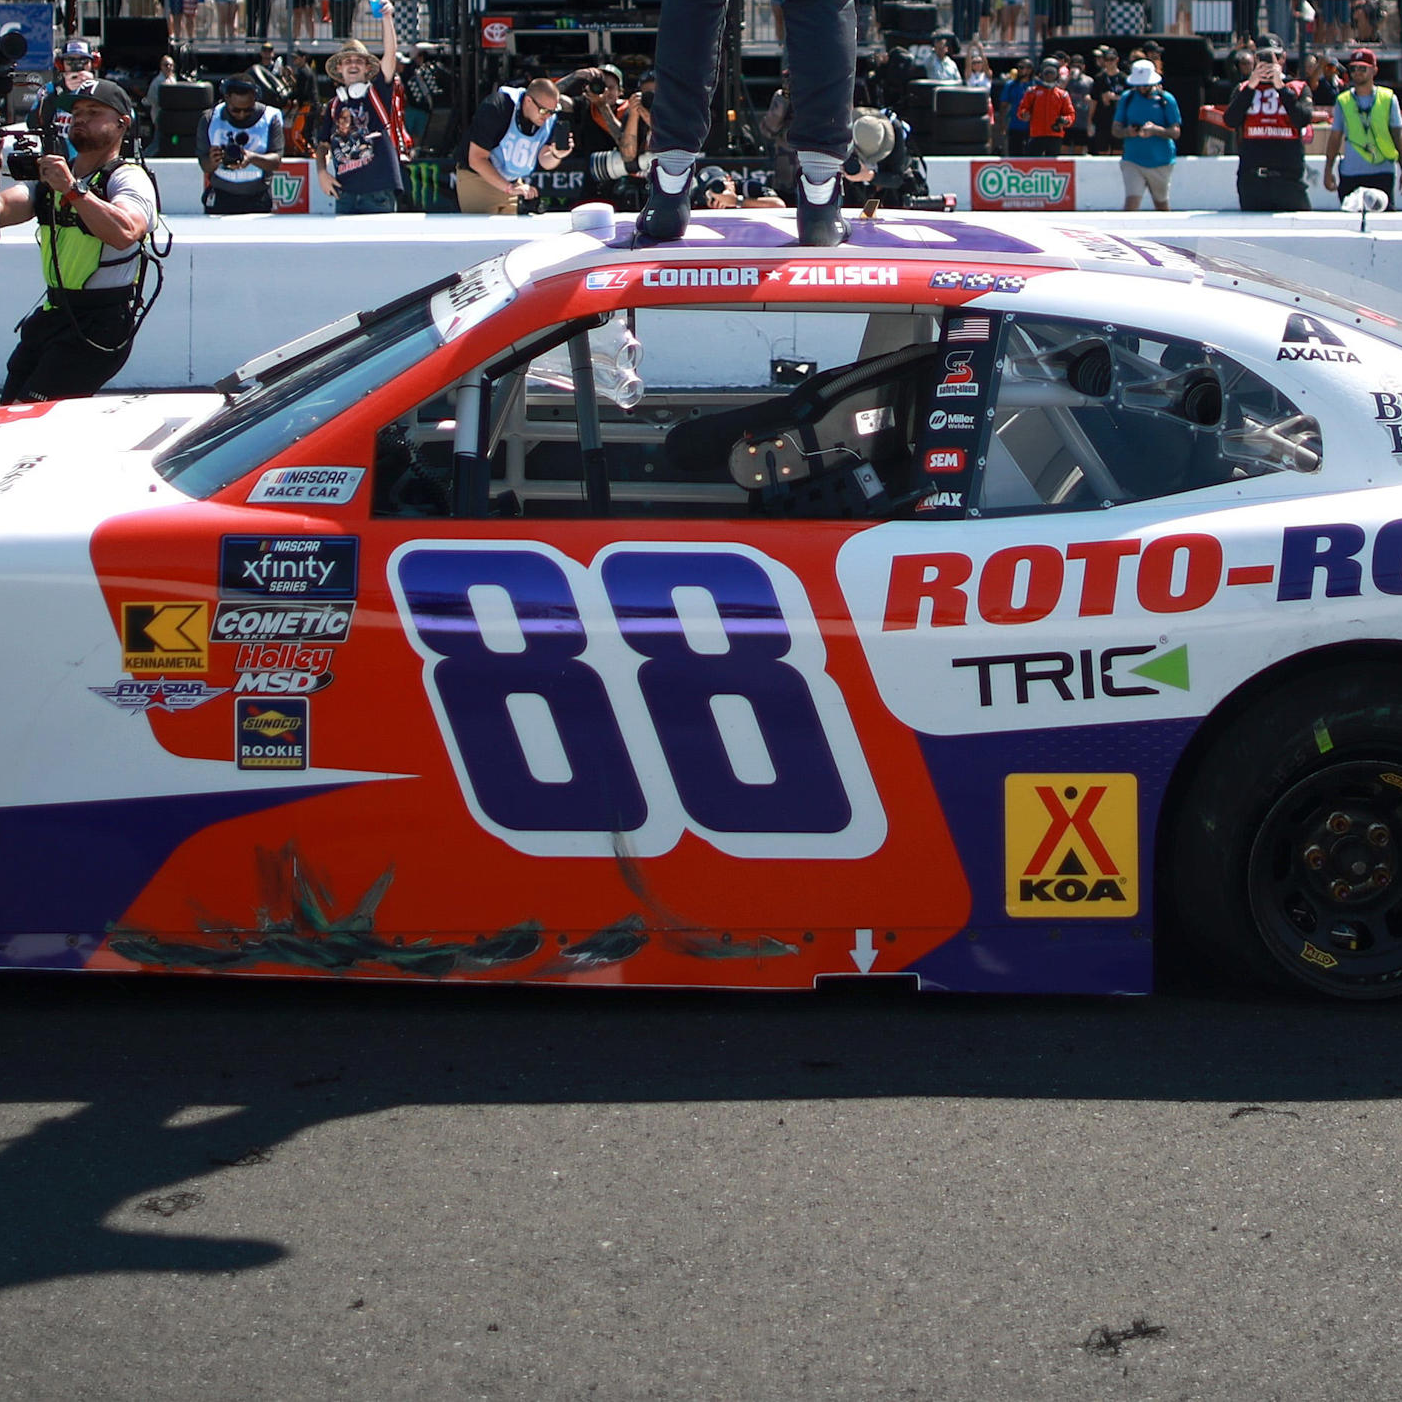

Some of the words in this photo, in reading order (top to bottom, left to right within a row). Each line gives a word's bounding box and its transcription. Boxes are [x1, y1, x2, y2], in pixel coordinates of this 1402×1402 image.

[981, 168, 1068, 199] O'Reilly
[642, 267, 759, 287] CONNOR
[788, 265, 898, 286] ZILISCH
[1276, 347, 1362, 364] AXALTA
[948, 414, 975, 424] Miller
[929, 454, 958, 467] SEM
[288, 470, 348, 485] NASCAR
[264, 486, 304, 498] RACE
[308, 486, 340, 498] CAR
[274, 540, 321, 552] NASCAR
[243, 553, 336, 586] xfinity
[269, 581, 308, 592] SERIES
[217, 609, 350, 635] COMETIC
[124, 657, 205, 669] KENNAMETAL
[235, 643, 334, 677] Holley
[233, 672, 321, 693] MSD
[952, 646, 1161, 707] TRIC
[116, 683, 163, 695] FIVE
[163, 683, 203, 695] STAR
[392, 544, 870, 846] 88
[243, 716, 299, 730] SUNOCO
[241, 745, 303, 758] ROOKIE
[1019, 878, 1126, 902] KOA
